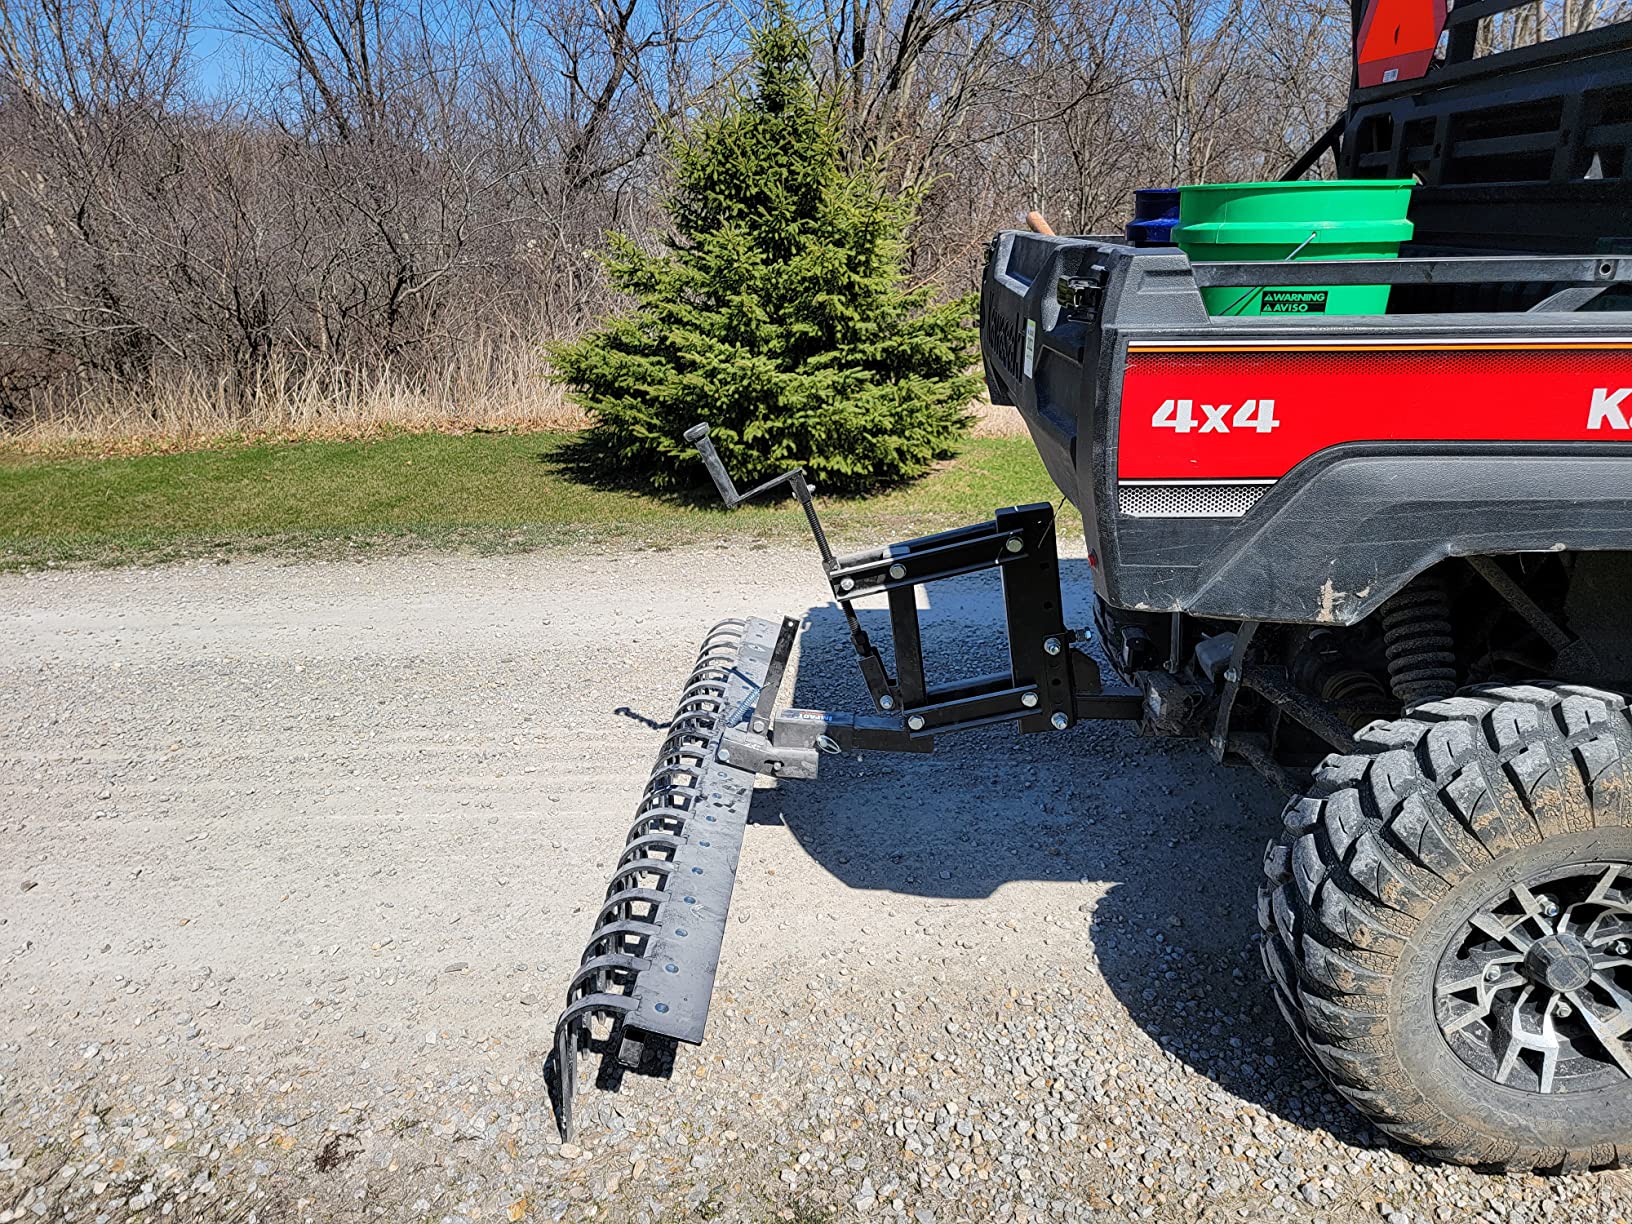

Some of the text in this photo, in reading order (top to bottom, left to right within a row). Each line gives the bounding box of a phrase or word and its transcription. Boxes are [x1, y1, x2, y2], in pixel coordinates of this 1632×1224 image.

[1273, 293, 1325, 302] WARNING
[1273, 303, 1308, 312] AVISO
[1151, 399, 1281, 433] 4x4
[1586, 388, 1632, 430] K
